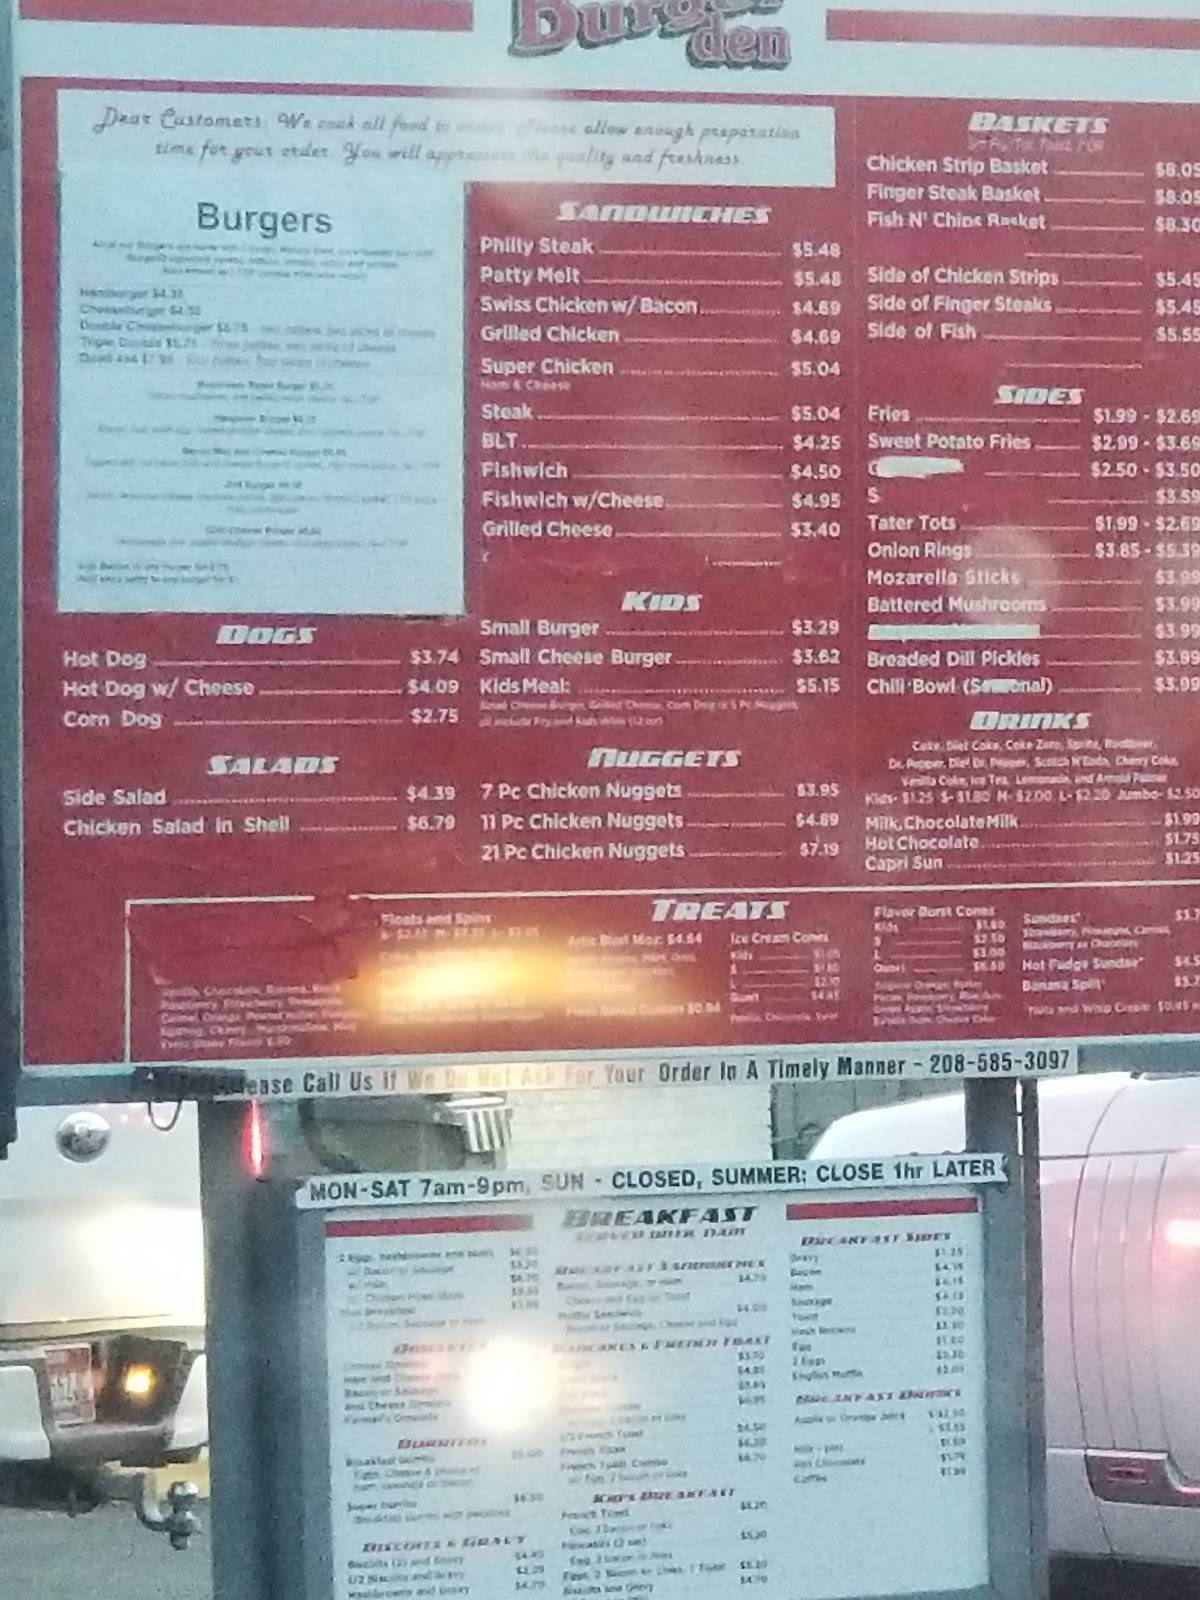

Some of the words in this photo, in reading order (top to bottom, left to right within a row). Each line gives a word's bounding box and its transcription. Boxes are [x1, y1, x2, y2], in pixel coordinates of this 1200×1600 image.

[686, 12, 791, 70] den
[93, 107, 151, 134] Dear
[318, 117, 355, 131] cook
[362, 116, 385, 131] all
[389, 115, 430, 138] food
[584, 121, 628, 136] allow
[634, 124, 694, 143] enough
[699, 125, 800, 144] preparation
[155, 142, 194, 156] time
[200, 141, 227, 162] for
[232, 146, 272, 163] your
[342, 142, 380, 164] You
[388, 145, 422, 160] will
[557, 151, 615, 170] quality
[622, 152, 652, 164] and
[867, 156, 937, 173] Chicken
[942, 158, 983, 176] Strip
[990, 159, 1048, 175] Basket
[867, 184, 924, 203] Finger
[929, 186, 978, 201] Steak
[982, 186, 1040, 201] Basket
[197, 202, 333, 239] Burgers
[480, 238, 533, 256] Philly
[539, 238, 593, 254] Steak
[792, 242, 840, 258] $5.48
[480, 267, 534, 285] Patty
[537, 267, 580, 283] Melt
[868, 267, 906, 283] Side
[911, 267, 930, 283] of
[934, 268, 1003, 284] Chicken
[1009, 270, 1059, 287] Strips
[480, 297, 531, 313] Swiss
[535, 297, 607, 314] Chicken
[609, 297, 639, 315] w/
[640, 298, 697, 314] Bacon
[480, 326, 541, 342] Grilled
[547, 326, 619, 343] Chicken
[868, 323, 906, 338] Side
[915, 323, 933, 339] of
[941, 323, 977, 339] Fish
[480, 359, 535, 378] Super
[541, 358, 613, 375] Chicken
[791, 361, 840, 377] $5.04
[481, 404, 532, 421] Steak
[791, 406, 840, 421] $5.04
[868, 406, 910, 422] Fries
[482, 432, 518, 448] BLT
[792, 435, 841, 451] $4.25
[868, 433, 922, 449] Sweet
[927, 435, 984, 449] Potato
[990, 433, 1031, 449] Fries
[482, 462, 568, 479] Fishwich
[791, 464, 841, 480] $4.50
[1091, 462, 1137, 478] $2.50
[482, 492, 570, 508] Fishwich
[573, 491, 664, 510] w/Cheese
[792, 493, 841, 509] $4.95
[868, 515, 913, 531] Tater
[919, 515, 956, 531] Tots
[1095, 515, 1138, 531] $1.99
[868, 542, 919, 558] Onion
[924, 542, 972, 560] Rings
[867, 570, 957, 585] Mozarella
[964, 569, 1020, 585] Sticks
[867, 597, 942, 613] Battered
[949, 597, 1047, 613] Mushrooms
[480, 620, 531, 636] Small
[537, 620, 600, 639] Burger
[792, 620, 840, 637] $3.29
[63, 651, 100, 668] Hot
[106, 652, 146, 671] Dog
[410, 649, 459, 665] $3.74
[867, 651, 940, 667] Breaded
[947, 651, 974, 667] Dill
[981, 650, 1040, 667] Pickles
[63, 680, 100, 697] Hot
[105, 680, 145, 699] Dog
[153, 679, 180, 697] w/
[184, 679, 254, 696] Cheese
[408, 679, 459, 694] $4.09
[797, 679, 840, 694] $5.15
[63, 789, 106, 806] Side
[113, 789, 166, 806] Salad
[407, 786, 456, 801] $4.39
[480, 783, 492, 798] 7
[499, 784, 521, 799] Pc
[527, 783, 600, 799] Chicken
[605, 783, 682, 801] Nuggets
[797, 783, 840, 797] $3.95
[63, 819, 141, 837] Chicken
[153, 817, 204, 834] Salad
[244, 816, 290, 832] Shell
[408, 816, 456, 831] $6.79
[481, 845, 500, 860] 21
[504, 845, 528, 861] Pc
[531, 844, 604, 861] Chicken
[608, 843, 685, 861] Nuggets
[800, 842, 840, 857] $7.19
[866, 836, 894, 851] Hot
[897, 835, 979, 851] Chocolate
[866, 855, 909, 873] Capri
[912, 855, 943, 871] Sun
[956, 905, 995, 917] Cones
[1023, 958, 1045, 971] Hot
[1049, 957, 1089, 972] Fudge
[1023, 979, 1070, 992] Banana
[303, 1072, 340, 1093] Call
[350, 1070, 373, 1091] Us
[383, 1069, 397, 1089] If
[605, 1066, 644, 1084] Your
[659, 1062, 710, 1082] Order
[721, 1061, 736, 1081] In
[746, 1059, 759, 1080] A
[768, 1059, 828, 1080] Timely
[837, 1055, 906, 1077] Manner
[930, 1049, 1070, 1074] 208-585-3097
[310, 1180, 410, 1202] MON-SAT
[541, 1173, 584, 1191] SUN
[611, 1167, 702, 1191] CLOSED,
[816, 1162, 884, 1183] CLOSE
[893, 1163, 924, 1180] 1hr
[932, 1158, 996, 1178] LATER
